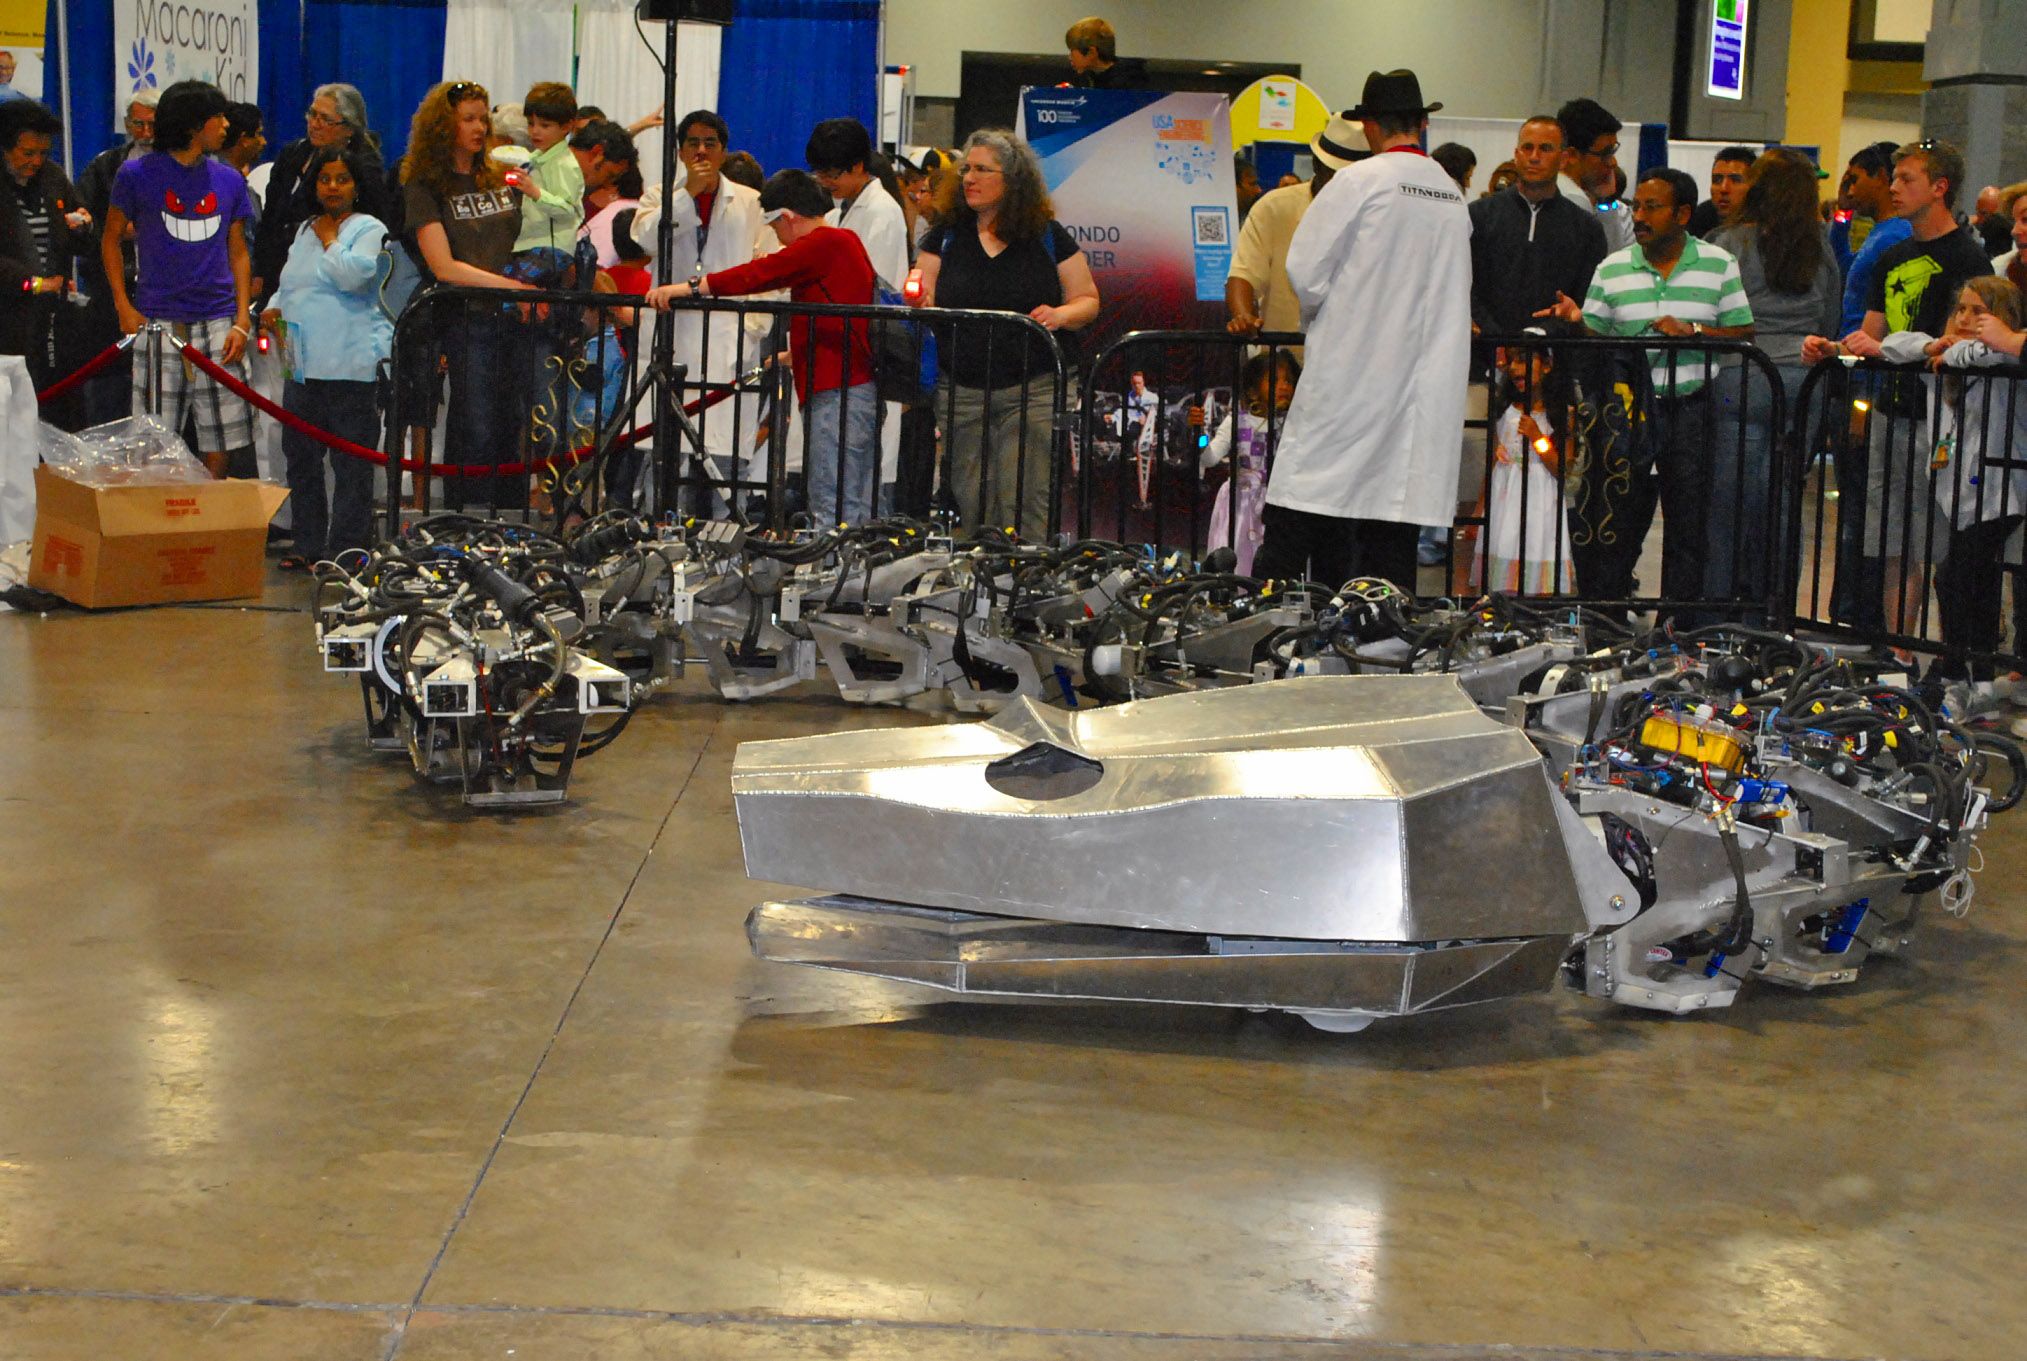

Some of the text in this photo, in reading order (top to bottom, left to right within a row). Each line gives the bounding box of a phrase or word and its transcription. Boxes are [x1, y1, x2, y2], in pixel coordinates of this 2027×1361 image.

[136, 0, 248, 57] Macaroni
[215, 56, 247, 104] Kid
[1037, 109, 1057, 123] 100
[1152, 114, 1175, 129] USA
